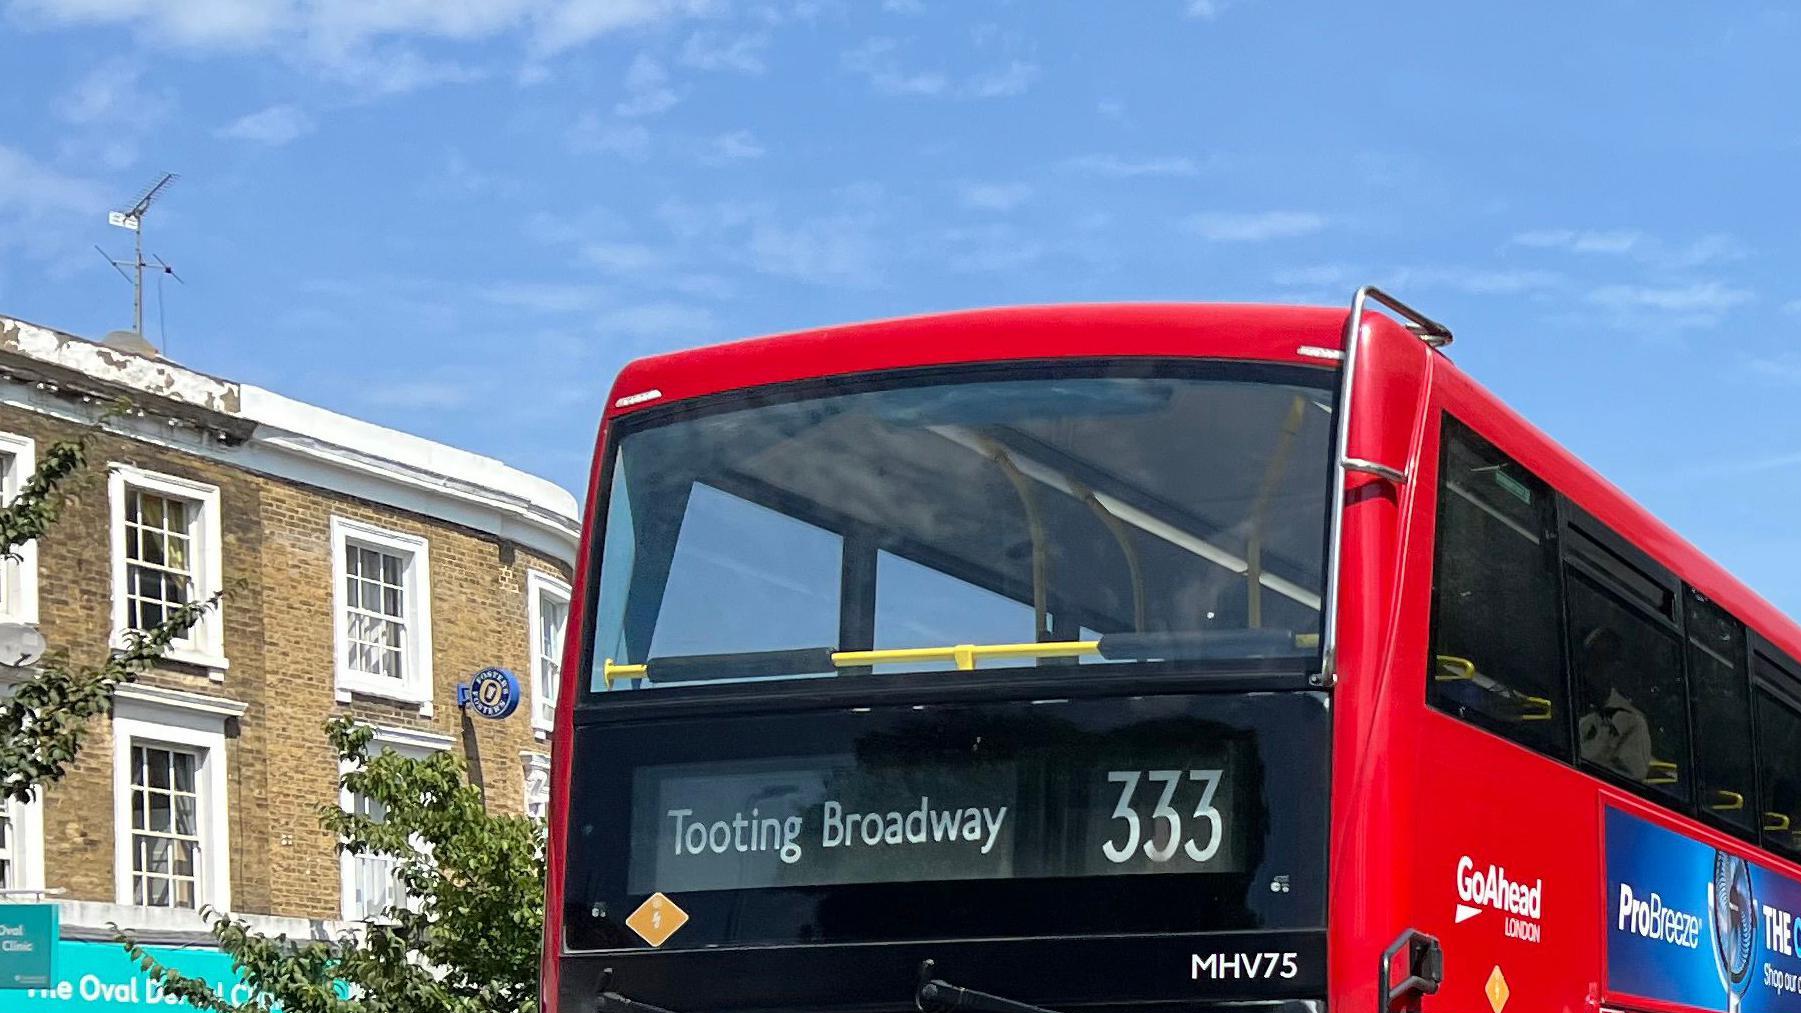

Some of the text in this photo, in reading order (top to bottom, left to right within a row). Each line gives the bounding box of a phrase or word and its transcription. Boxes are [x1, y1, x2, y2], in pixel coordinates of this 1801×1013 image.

[667, 796, 1007, 864] Tooting Broadway
[1102, 769, 1224, 863] 333
[1456, 855, 1542, 919] GoAhead
[1504, 916, 1541, 943] LONDON
[1618, 882, 1699, 949] ProBreeze
[1763, 904, 1792, 956] THE
[2, 941, 34, 952] Clinic
[1191, 953, 1298, 979] MHV75
[79, 974, 139, 1003] Oval
[1763, 962, 1783, 995] Shop
[1784, 971, 1798, 993] our
